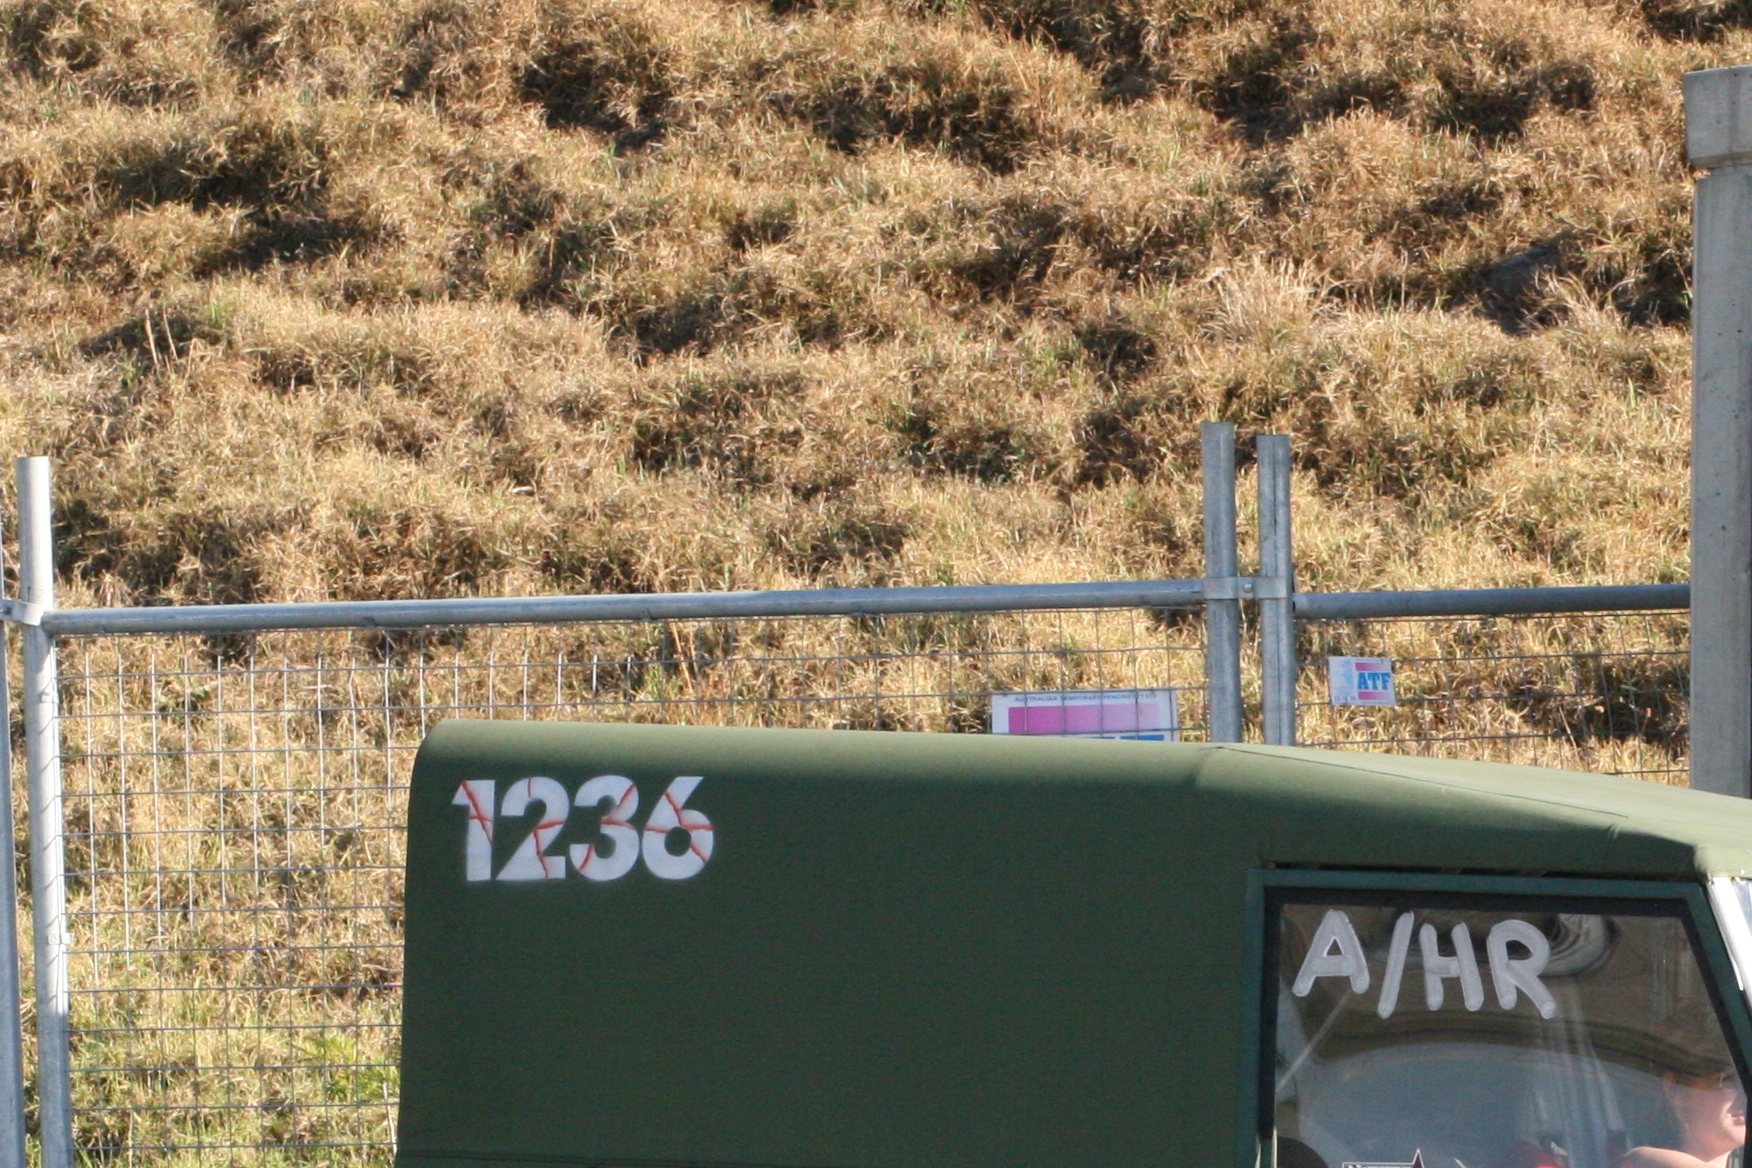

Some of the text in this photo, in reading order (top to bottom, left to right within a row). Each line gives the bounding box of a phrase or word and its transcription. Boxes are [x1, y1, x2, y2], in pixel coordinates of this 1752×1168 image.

[1357, 672, 1391, 691] ATF
[453, 775, 715, 883] 1236
[1292, 909, 1557, 1020] A/HR
